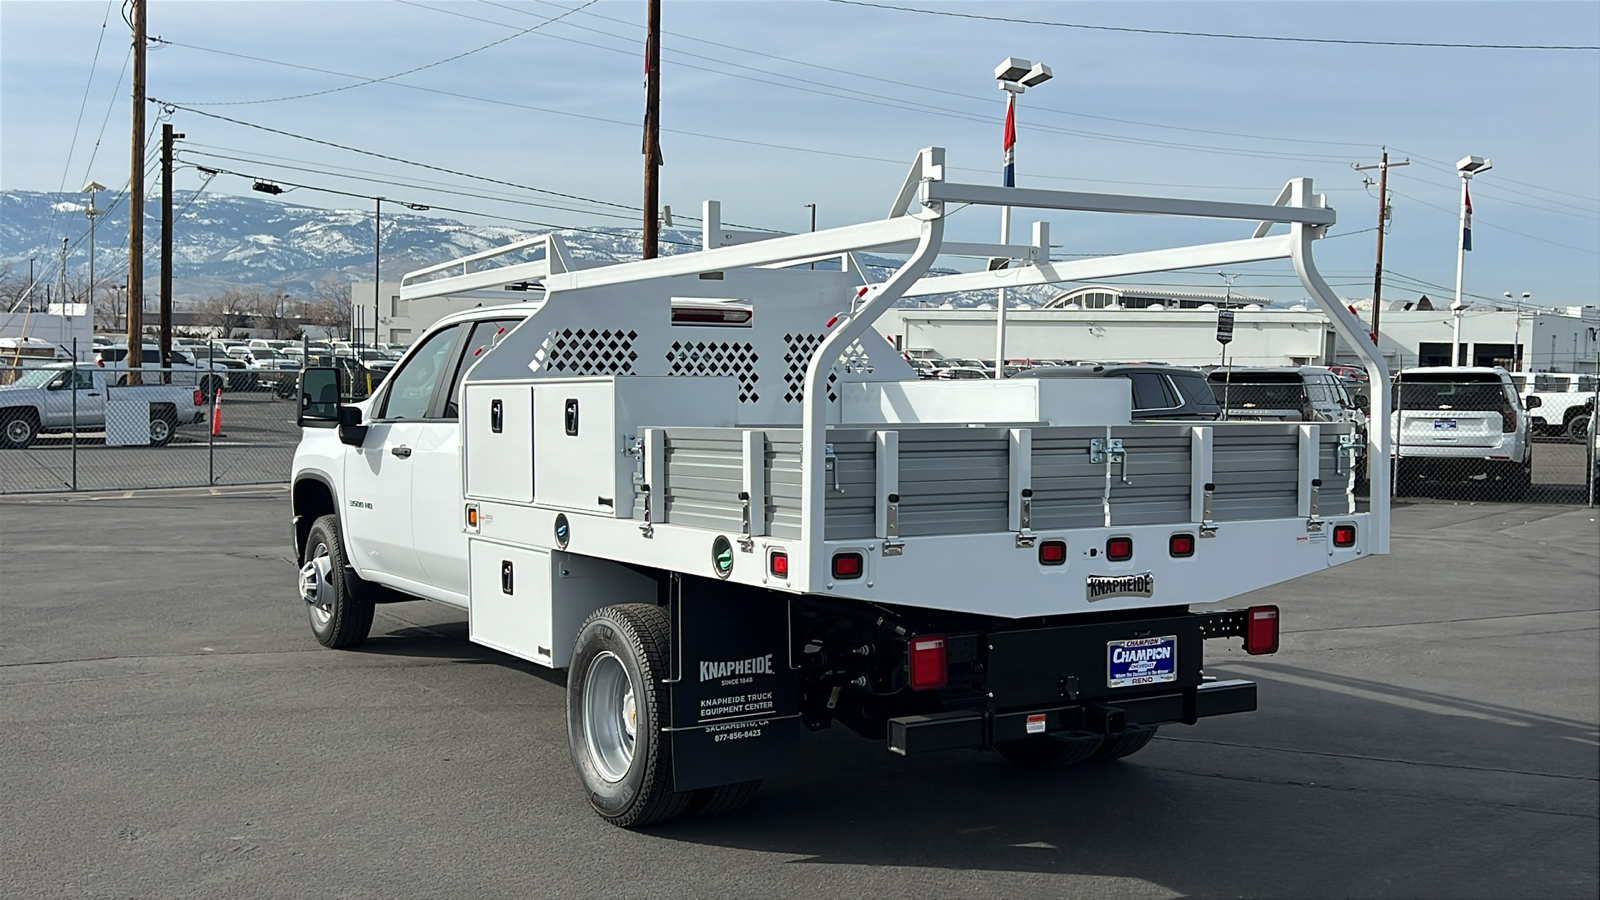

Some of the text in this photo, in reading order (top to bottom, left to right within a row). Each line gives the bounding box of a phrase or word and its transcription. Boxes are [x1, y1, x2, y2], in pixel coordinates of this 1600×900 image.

[349, 500, 364, 508] 3500
[1090, 573, 1151, 597] KNAPHEIDE
[1127, 638, 1158, 646] CHAMPION
[1113, 647, 1171, 663] CHAMPION
[721, 678, 739, 686] SINCE
[700, 692, 773, 707] KNAPHEIDE TRUCK
[700, 701, 773, 716] EQUIPMENT CENTER
[714, 729, 761, 742] 877-856-8423
